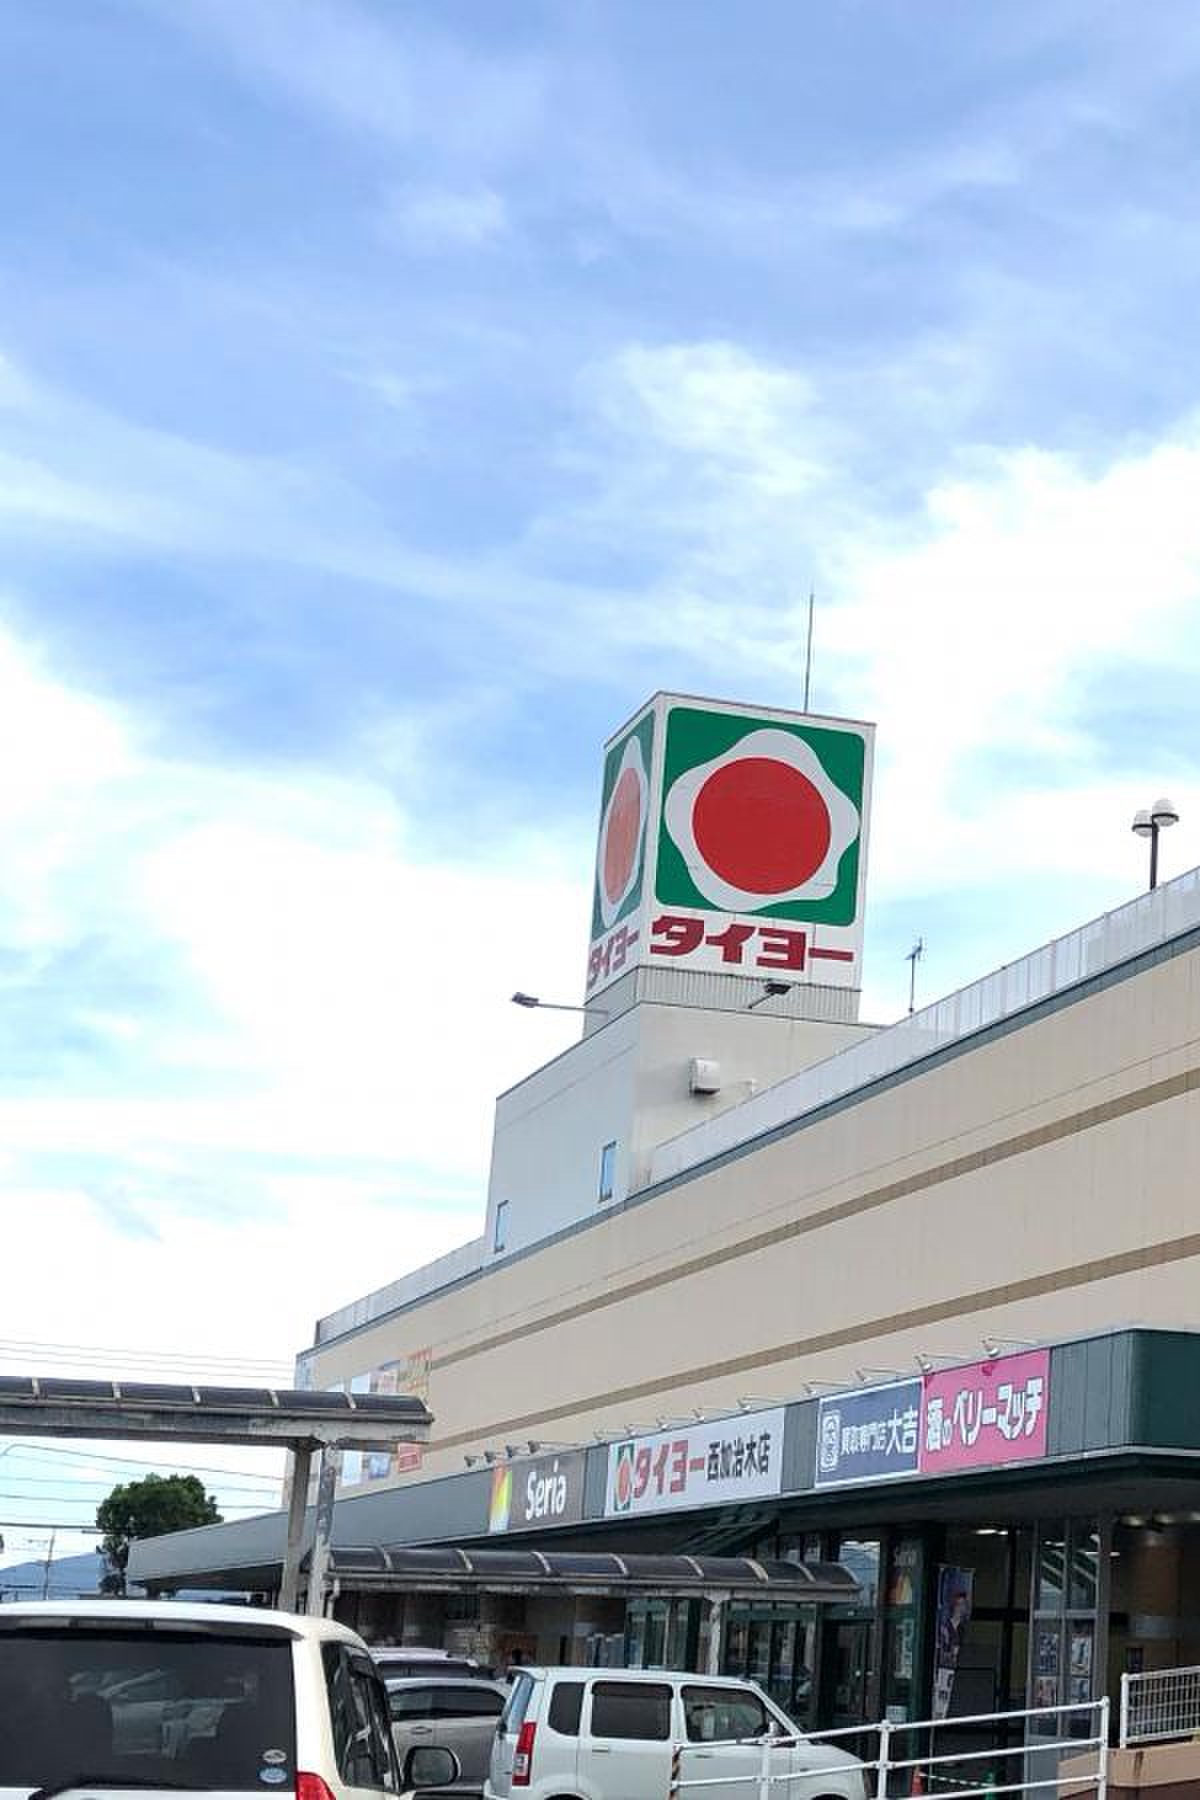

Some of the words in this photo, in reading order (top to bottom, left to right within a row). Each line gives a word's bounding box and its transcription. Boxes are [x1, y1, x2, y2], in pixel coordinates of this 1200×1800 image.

[650, 915, 854, 971] タイヨー
[525, 1461, 567, 1520] Seria
